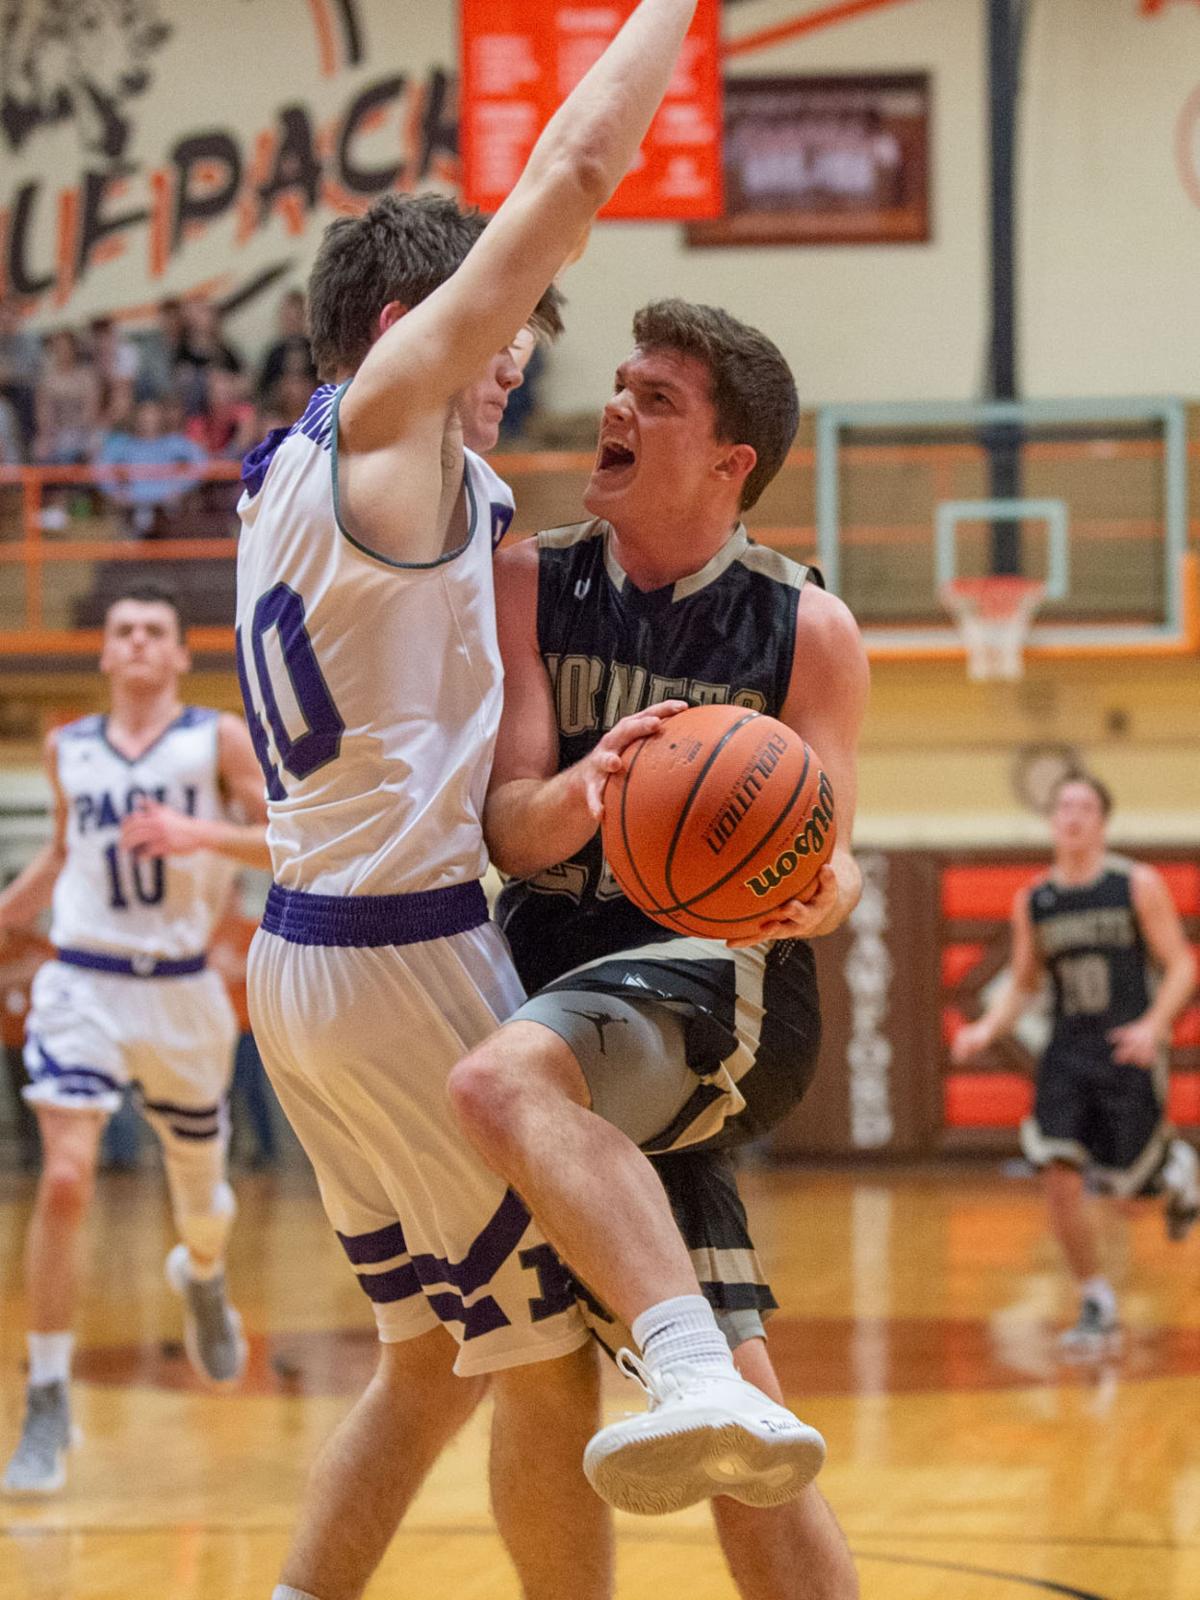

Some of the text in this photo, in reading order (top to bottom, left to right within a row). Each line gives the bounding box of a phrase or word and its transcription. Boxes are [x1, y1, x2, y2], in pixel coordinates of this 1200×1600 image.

[705, 733, 788, 856] EVOLUTION
[744, 769, 834, 897] Wilson
[104, 842, 165, 909] 10
